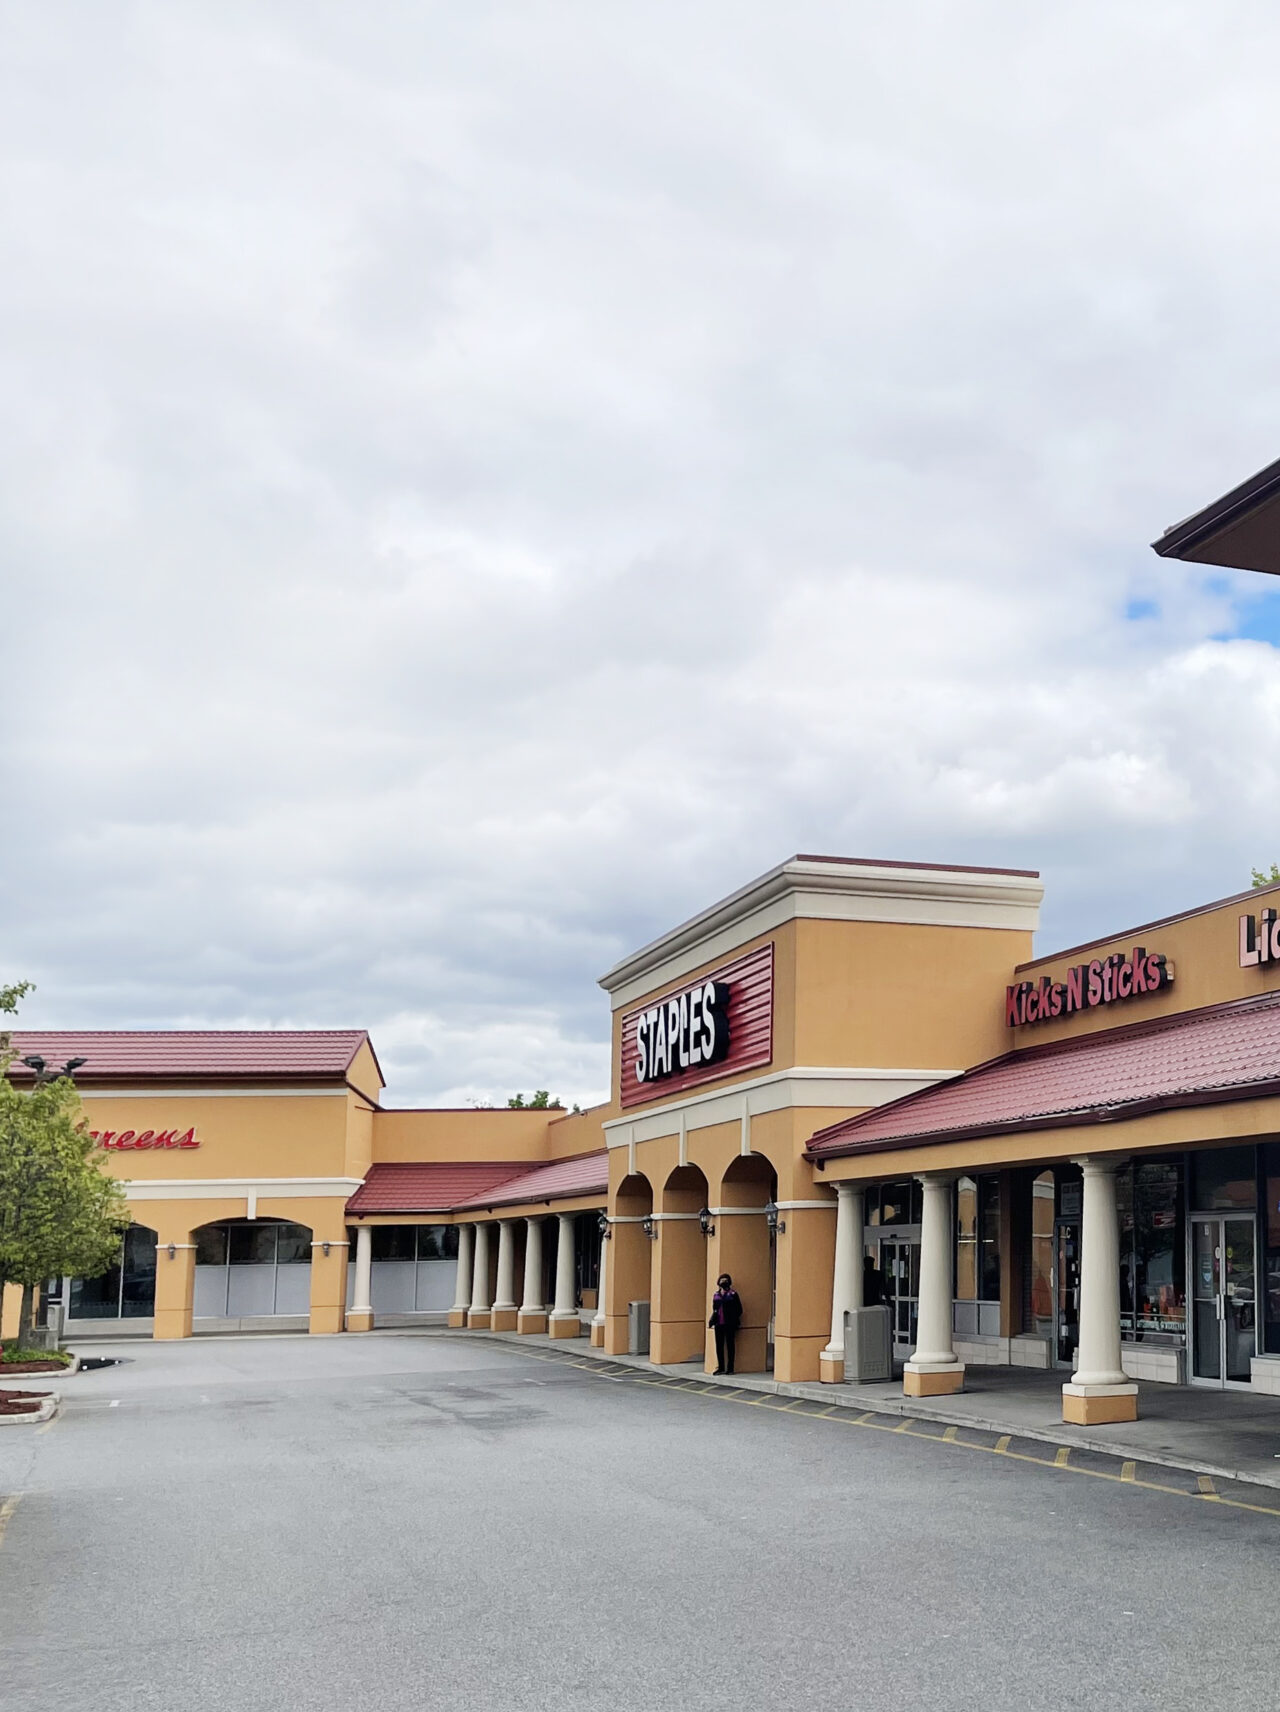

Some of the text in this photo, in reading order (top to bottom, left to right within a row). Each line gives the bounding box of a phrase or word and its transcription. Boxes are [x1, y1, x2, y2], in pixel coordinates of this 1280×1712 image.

[635, 981, 716, 1083] STAPLES
[1006, 947, 1165, 1027] Kicks N Sticks
